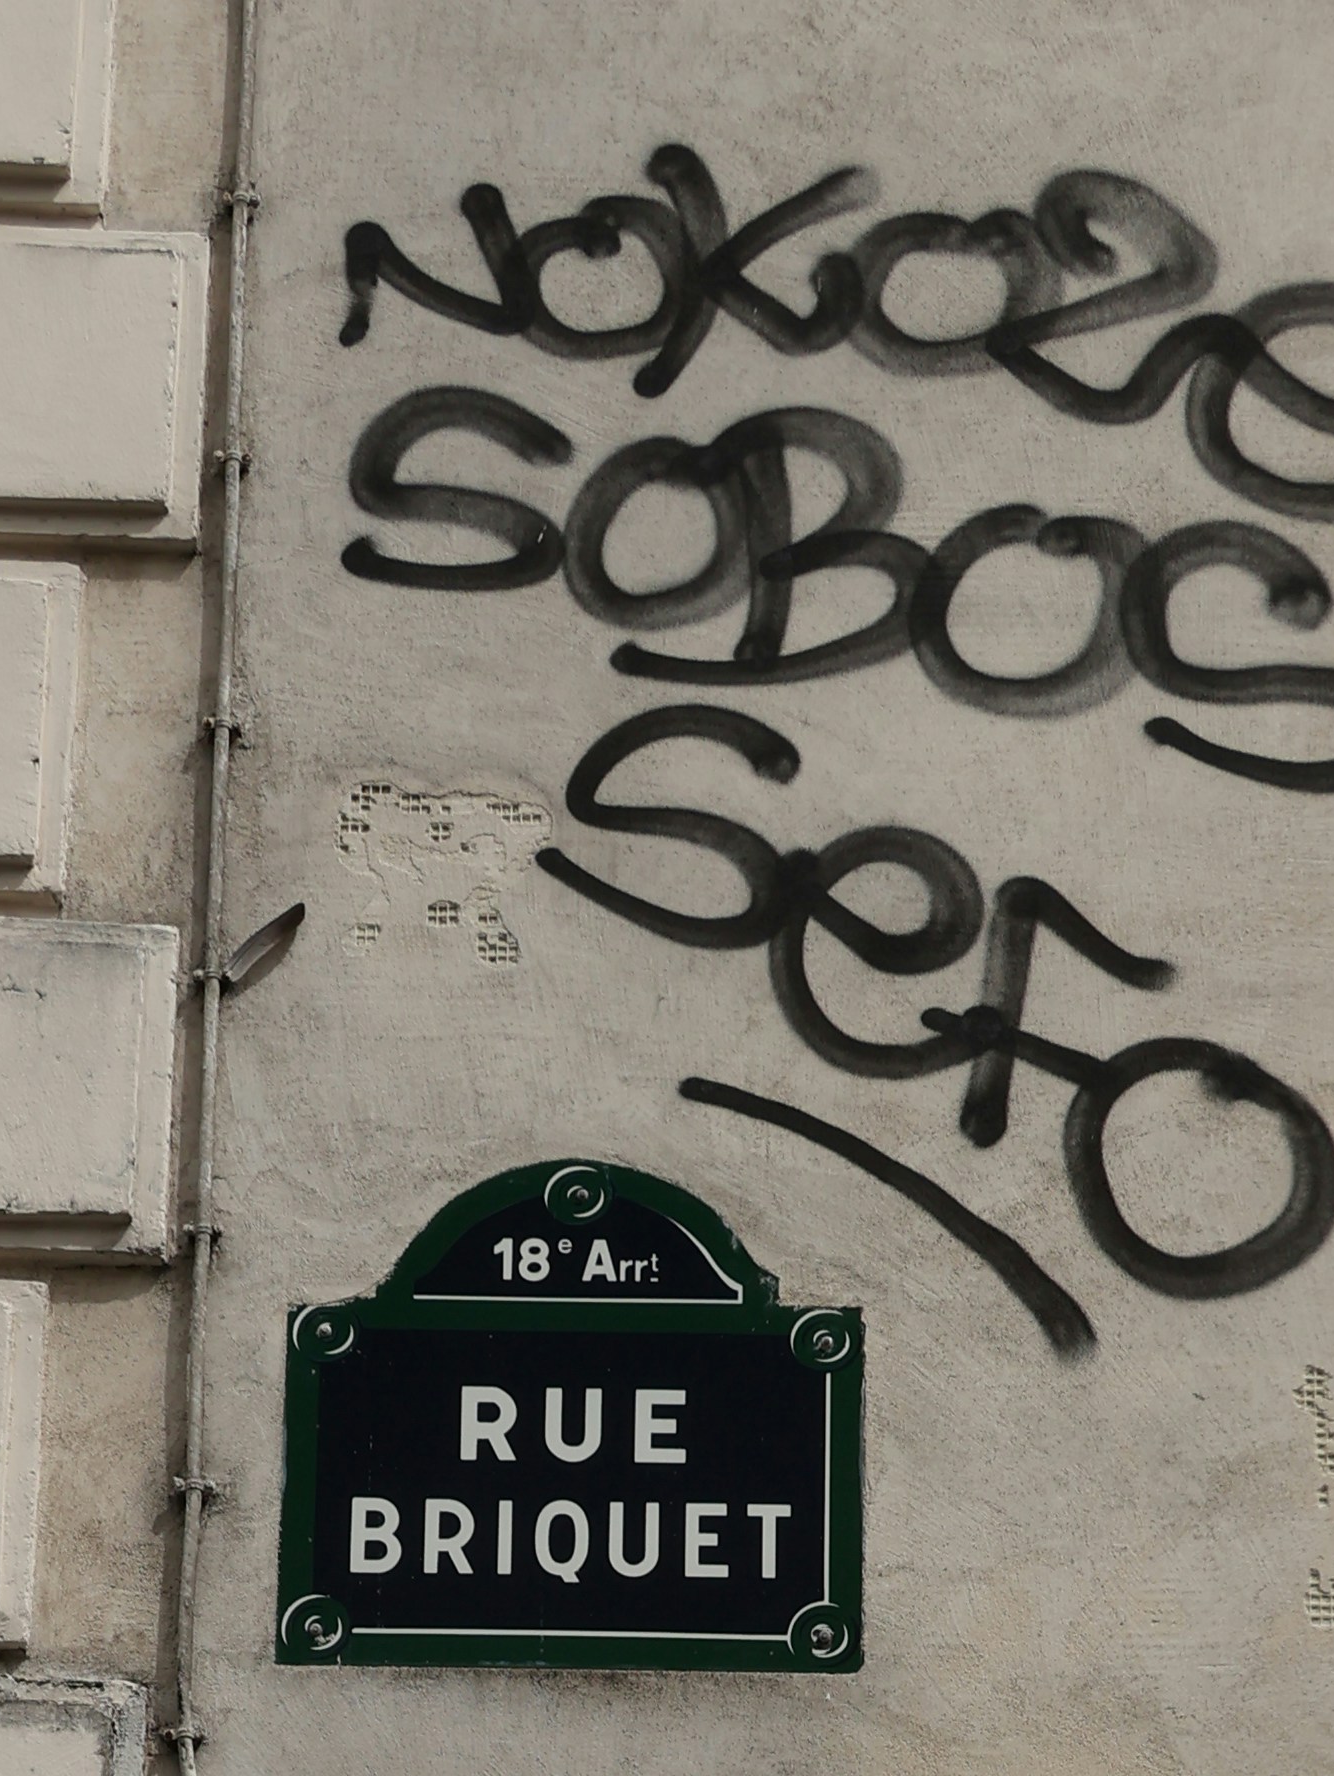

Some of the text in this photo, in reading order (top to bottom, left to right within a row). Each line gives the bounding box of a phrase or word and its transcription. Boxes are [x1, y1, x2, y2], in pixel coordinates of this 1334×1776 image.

[493, 1237, 572, 1282] 18e
[459, 1384, 687, 1464] RUE
[349, 1496, 792, 1584] BRIQUET
